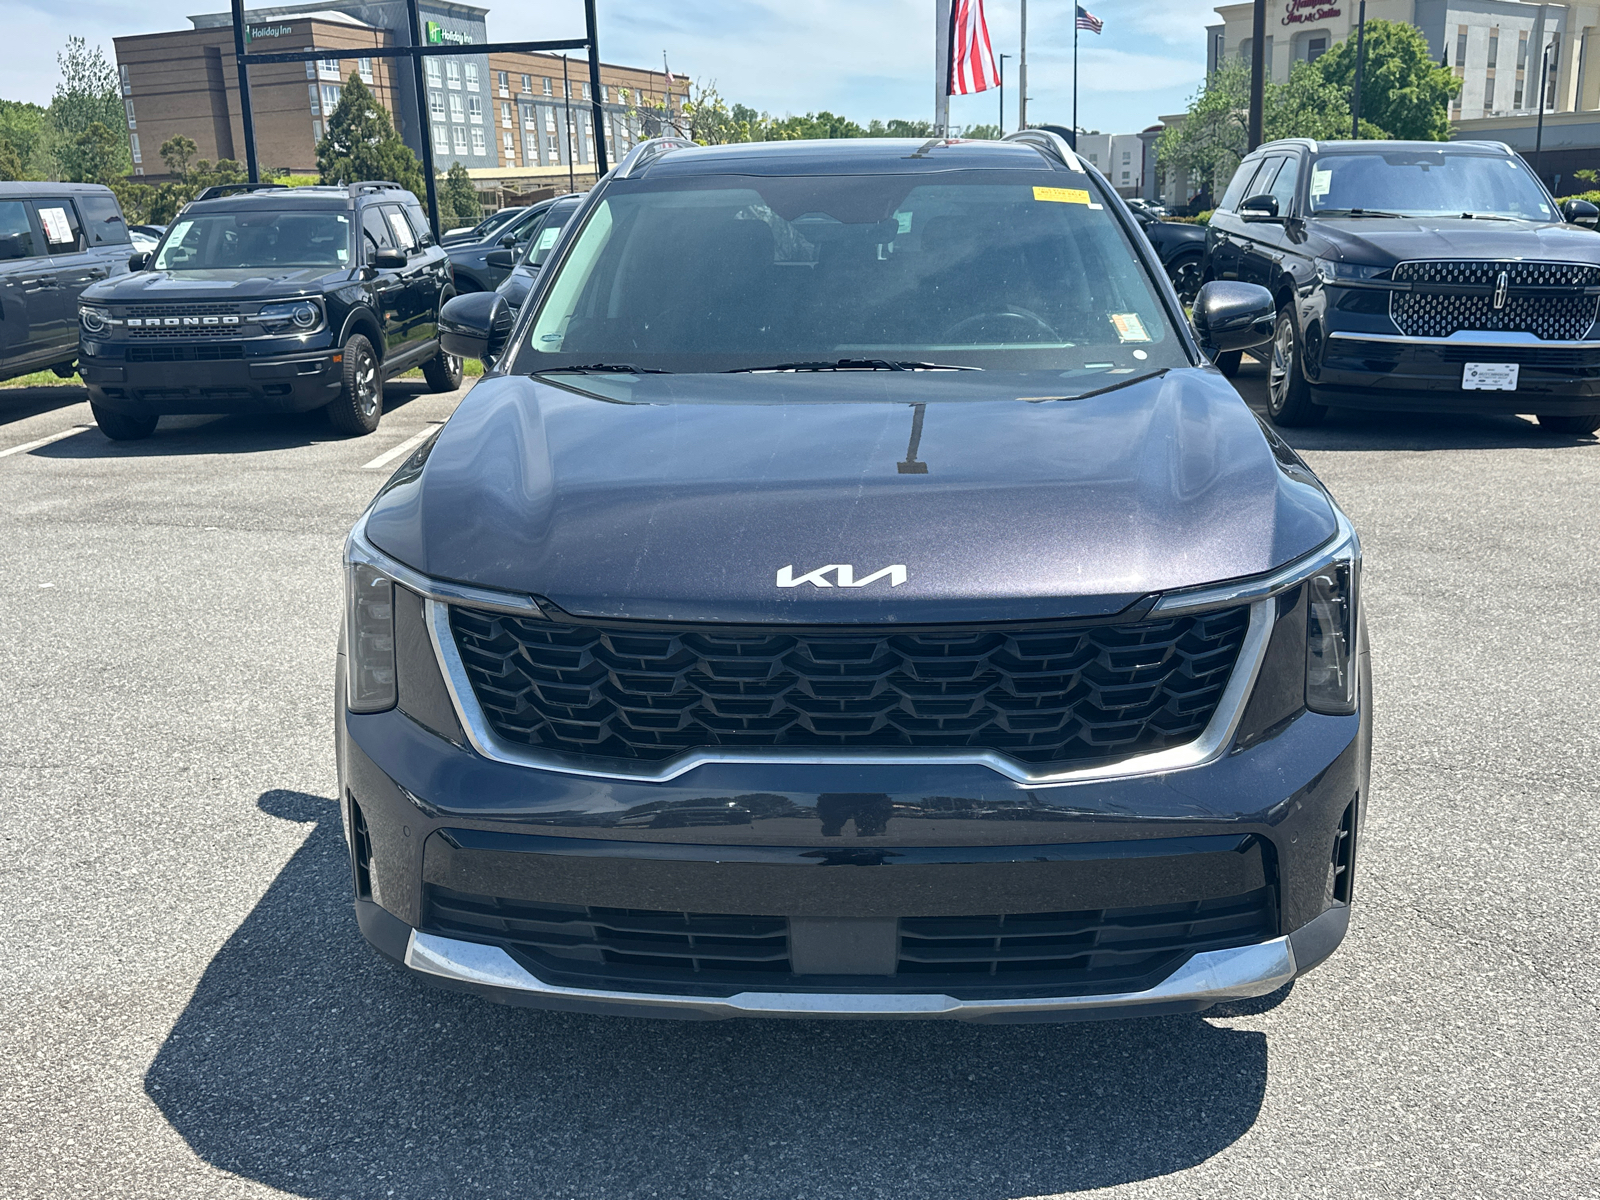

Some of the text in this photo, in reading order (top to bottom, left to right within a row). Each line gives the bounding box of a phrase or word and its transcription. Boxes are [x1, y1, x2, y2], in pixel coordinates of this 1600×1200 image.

[1281, 12, 1306, 26] Inn
[1312, 8, 1341, 21] Suites
[252, 25, 292, 38] Holiday Inn
[441, 28, 473, 45] Holiday Inn
[127, 316, 239, 326] BRONCO
[776, 564, 907, 588] KIA
